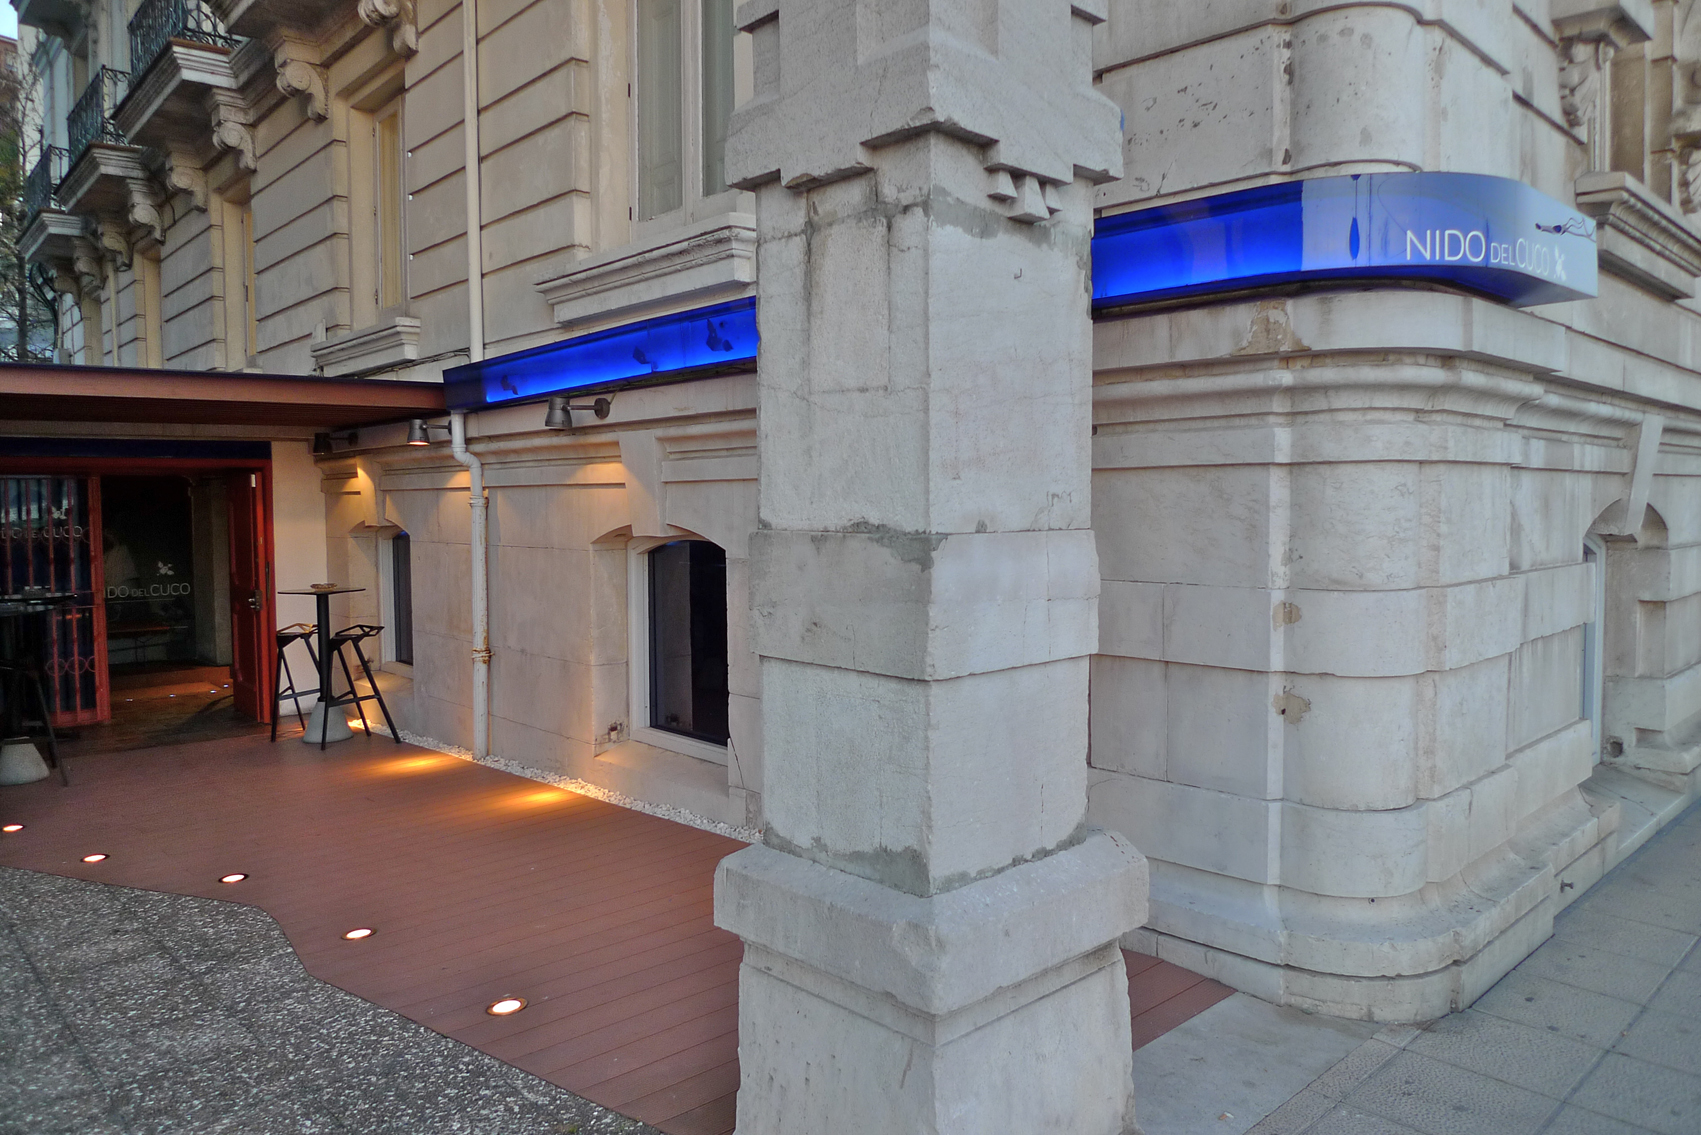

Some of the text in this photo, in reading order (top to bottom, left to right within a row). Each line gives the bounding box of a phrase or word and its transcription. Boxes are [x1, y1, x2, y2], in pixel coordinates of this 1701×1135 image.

[1406, 229, 1550, 276] NIDO DEL CUCO
[131, 588, 150, 597] DEL
[150, 582, 191, 596] CUCO
